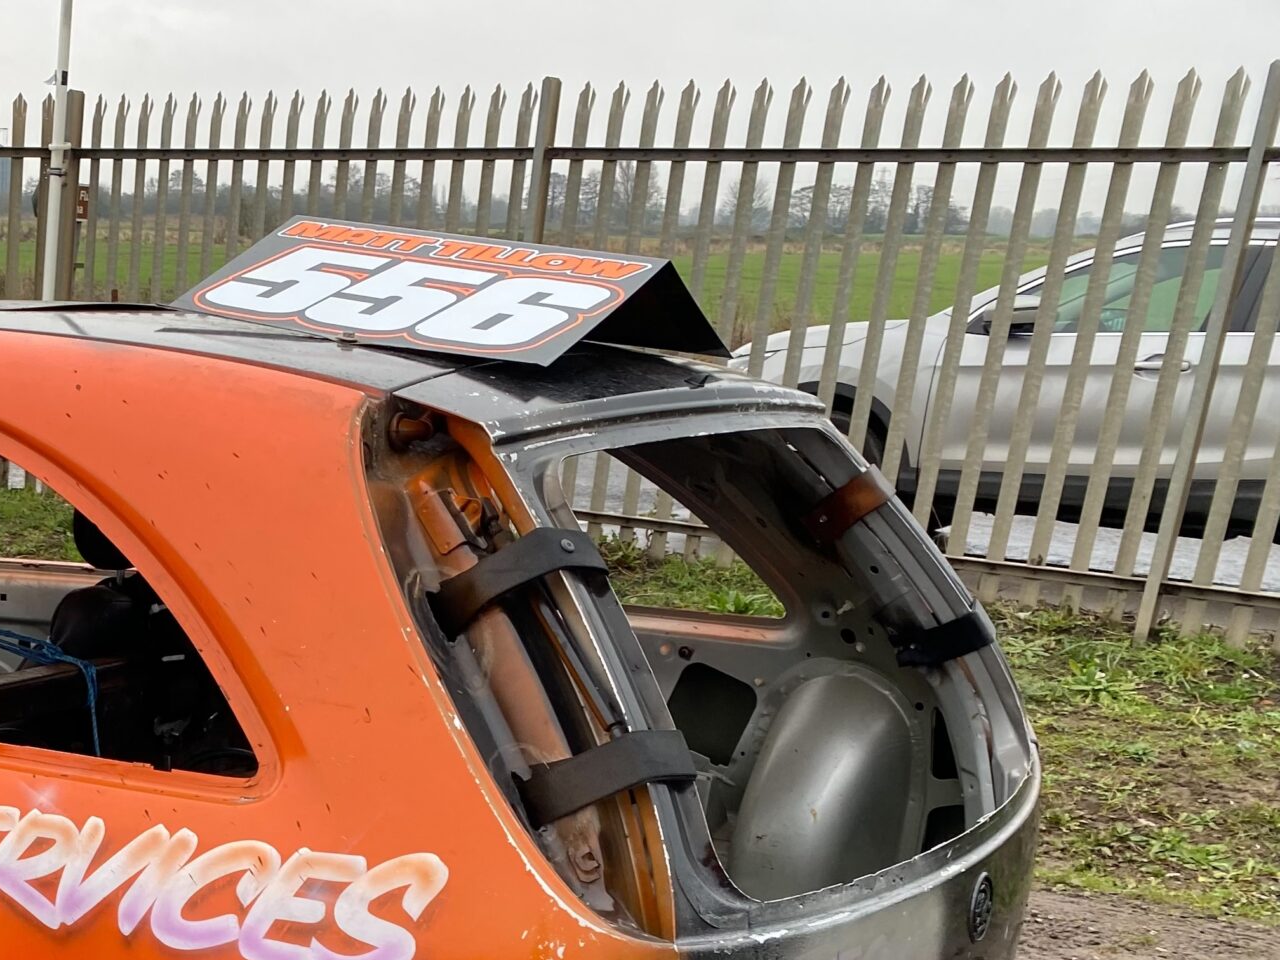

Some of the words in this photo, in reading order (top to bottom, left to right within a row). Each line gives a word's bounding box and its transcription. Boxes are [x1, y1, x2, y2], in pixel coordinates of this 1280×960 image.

[283, 220, 439, 253] MATT
[431, 239, 646, 279] TILLOW
[204, 246, 613, 347] 556
